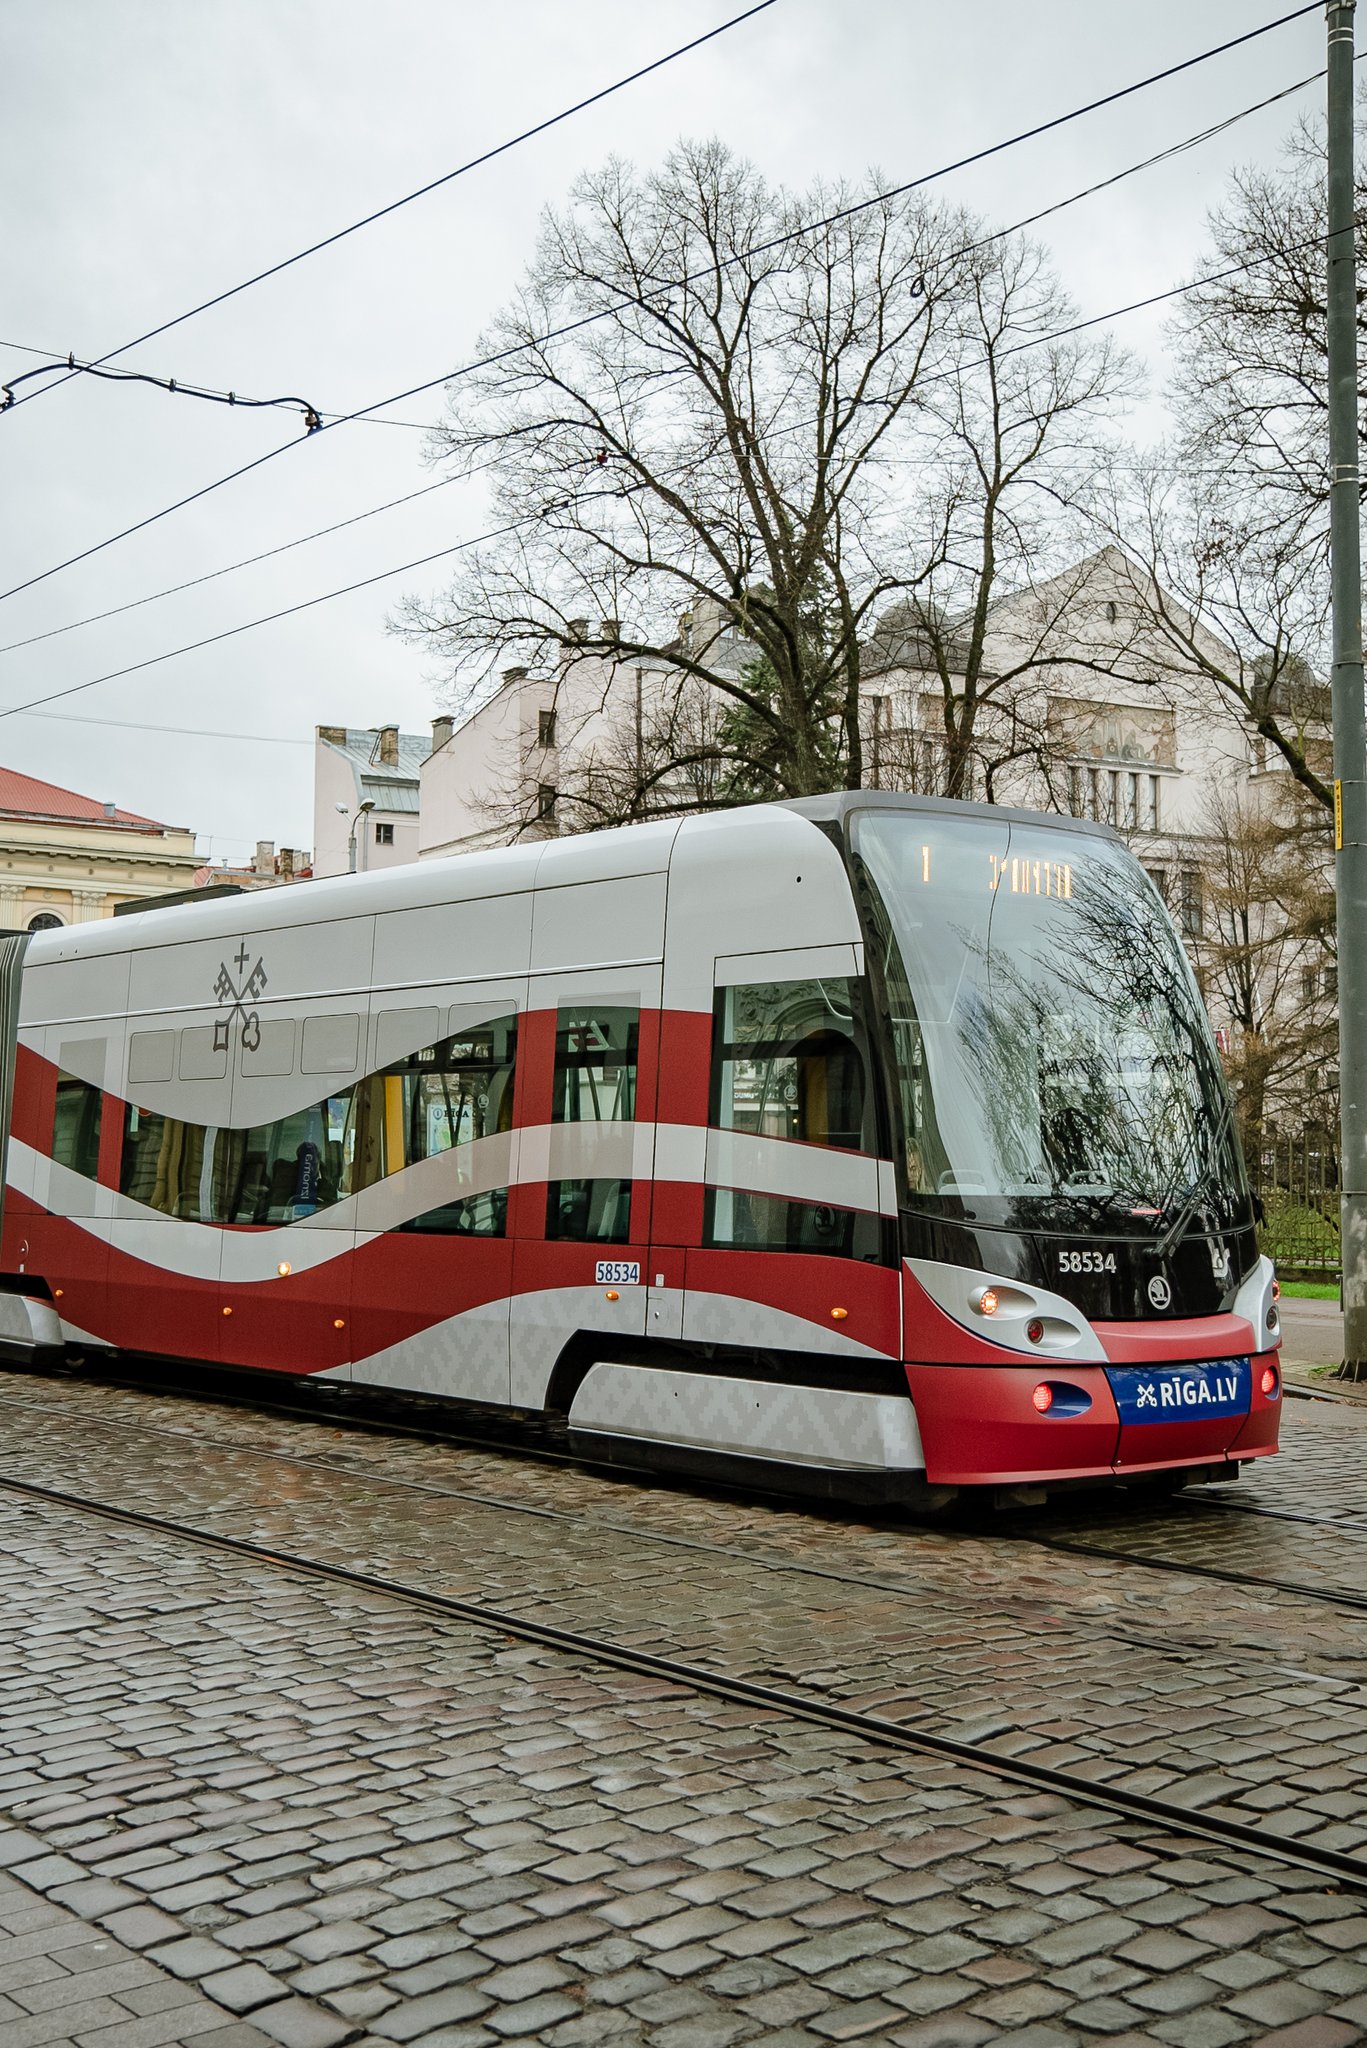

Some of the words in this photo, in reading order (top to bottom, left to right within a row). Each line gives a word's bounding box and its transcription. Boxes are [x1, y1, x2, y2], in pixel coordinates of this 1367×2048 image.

[597, 1263, 638, 1282] 58534
[1059, 1251, 1117, 1274] 58534
[1160, 1377, 1237, 1407] RĪGA.LV
